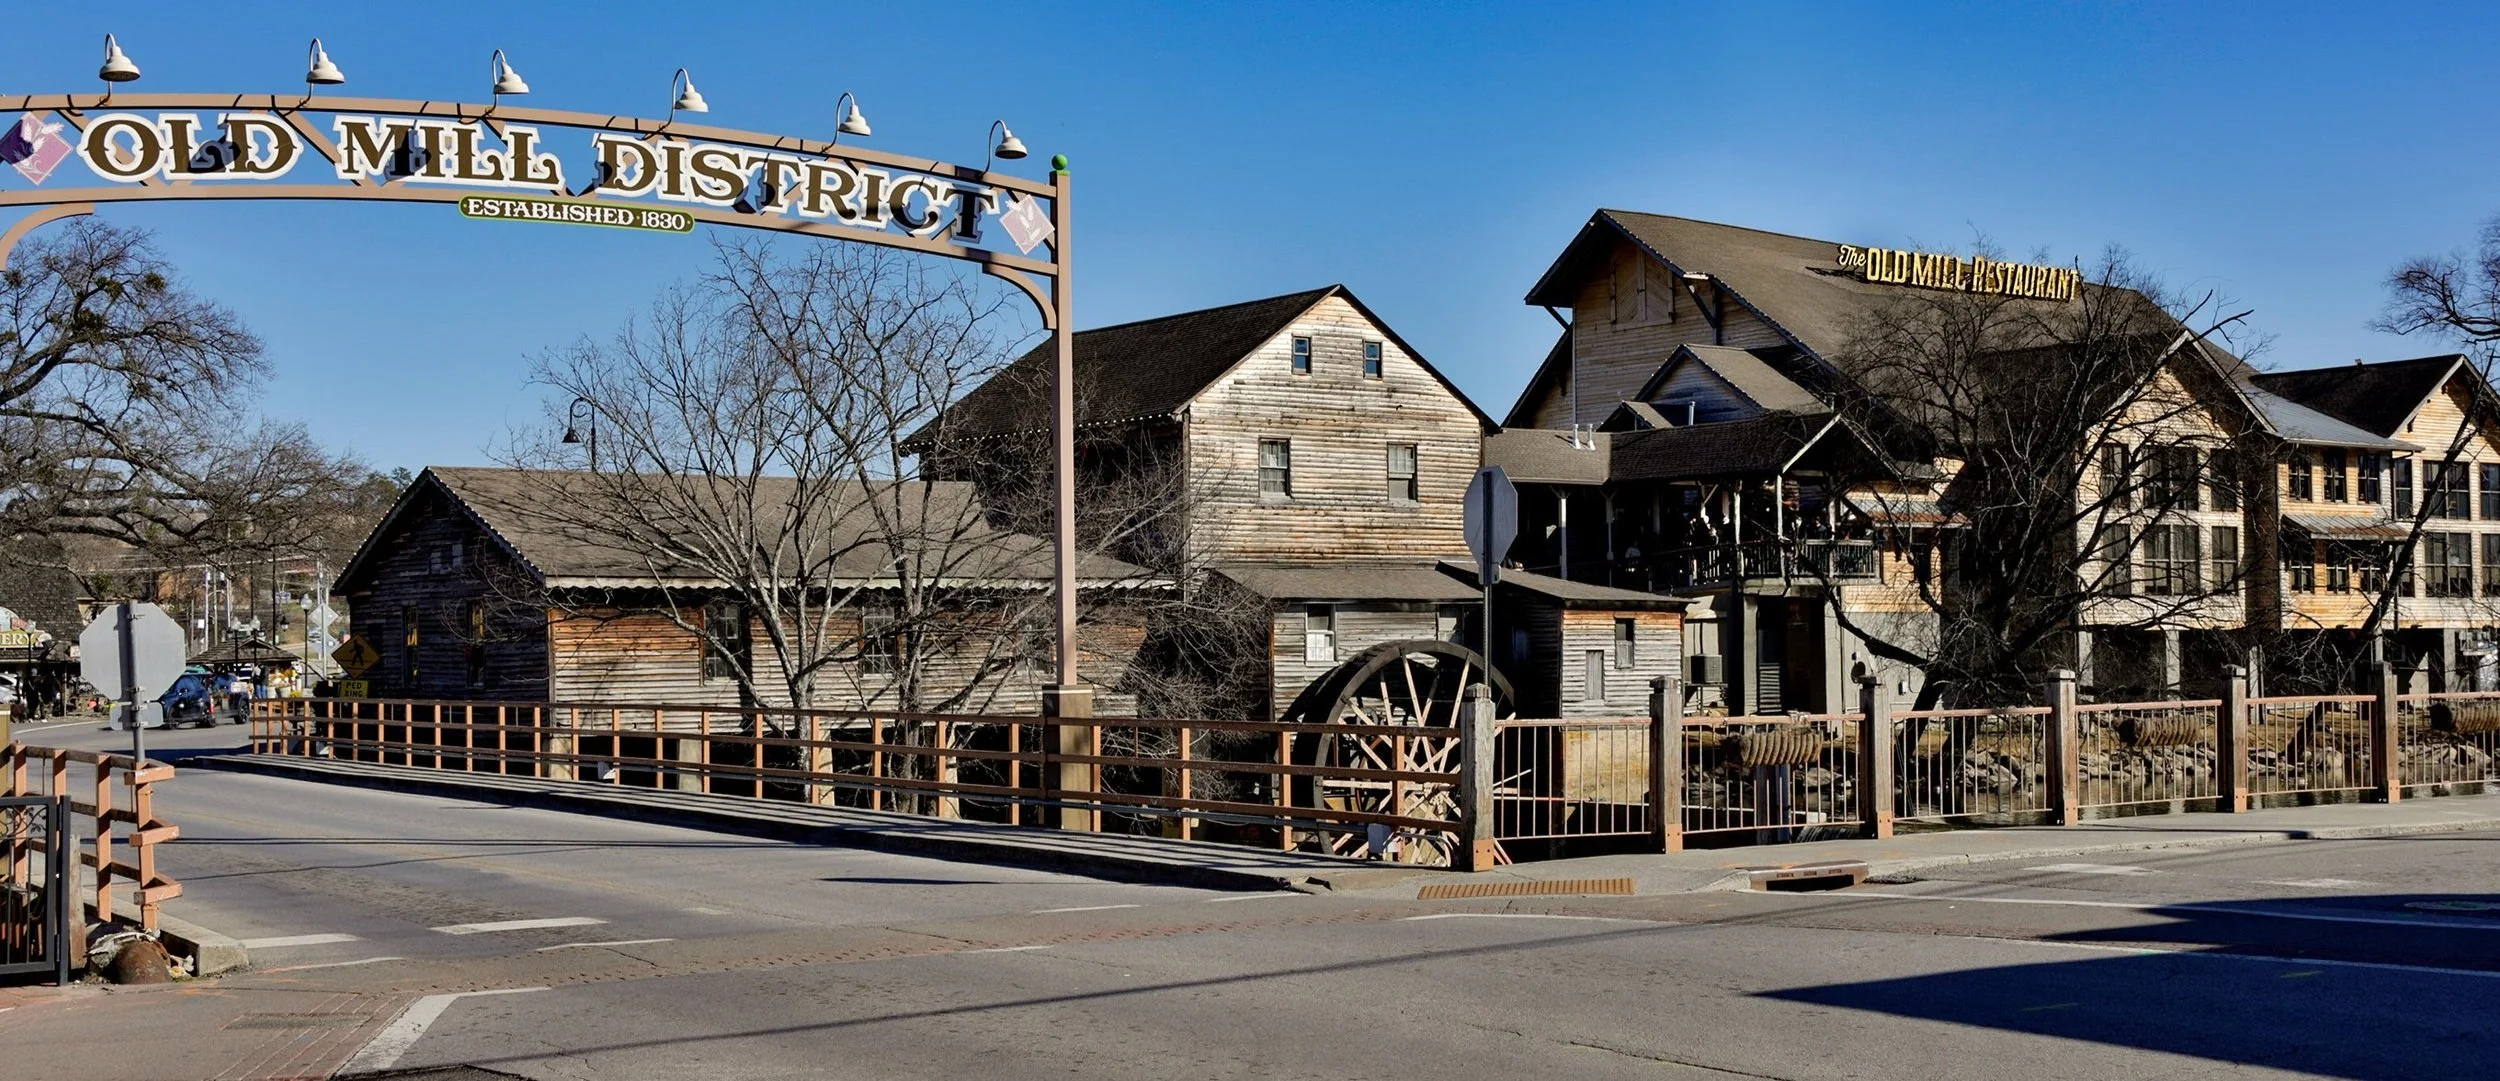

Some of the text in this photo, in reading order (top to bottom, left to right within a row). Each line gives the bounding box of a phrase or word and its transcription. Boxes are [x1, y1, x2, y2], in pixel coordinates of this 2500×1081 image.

[77, 113, 1000, 244] OLD MILL DISTRICT
[468, 199, 686, 230] ESTABLISHED 1830
[1839, 245, 2079, 300] The OLD MILL RESTAURANT
[344, 690, 363, 698] XING
[346, 682, 362, 690] PED
